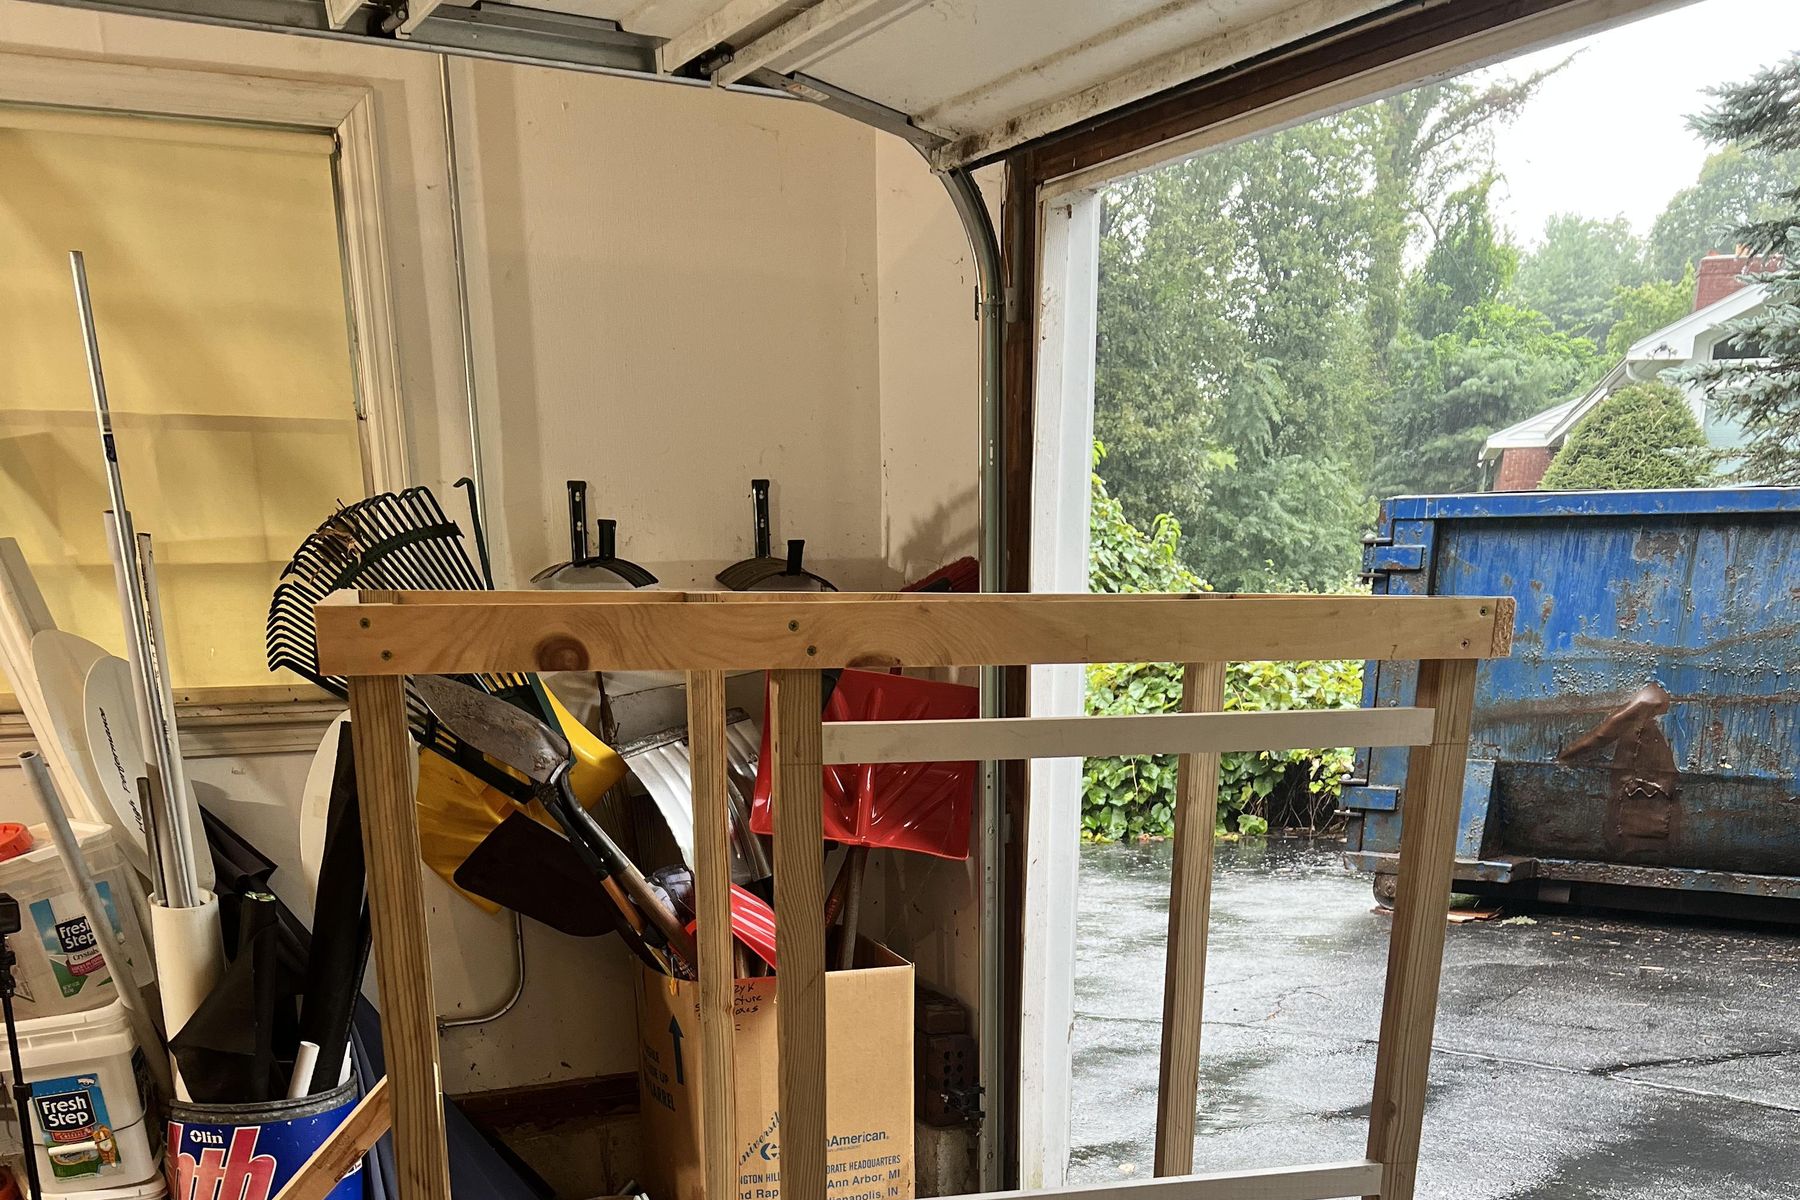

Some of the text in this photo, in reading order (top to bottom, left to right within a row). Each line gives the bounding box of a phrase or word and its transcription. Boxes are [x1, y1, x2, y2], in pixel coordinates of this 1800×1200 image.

[42, 1096, 88, 1115] Fresh
[48, 1111, 89, 1127] Step
[190, 1129, 224, 1144] Olin
[849, 1155, 901, 1171] HEADQUARTERS
[827, 1179, 849, 1189] Ann
[889, 1169, 900, 1180] MI
[756, 1189, 779, 1200] Rap
[888, 1186, 899, 1197] IN
